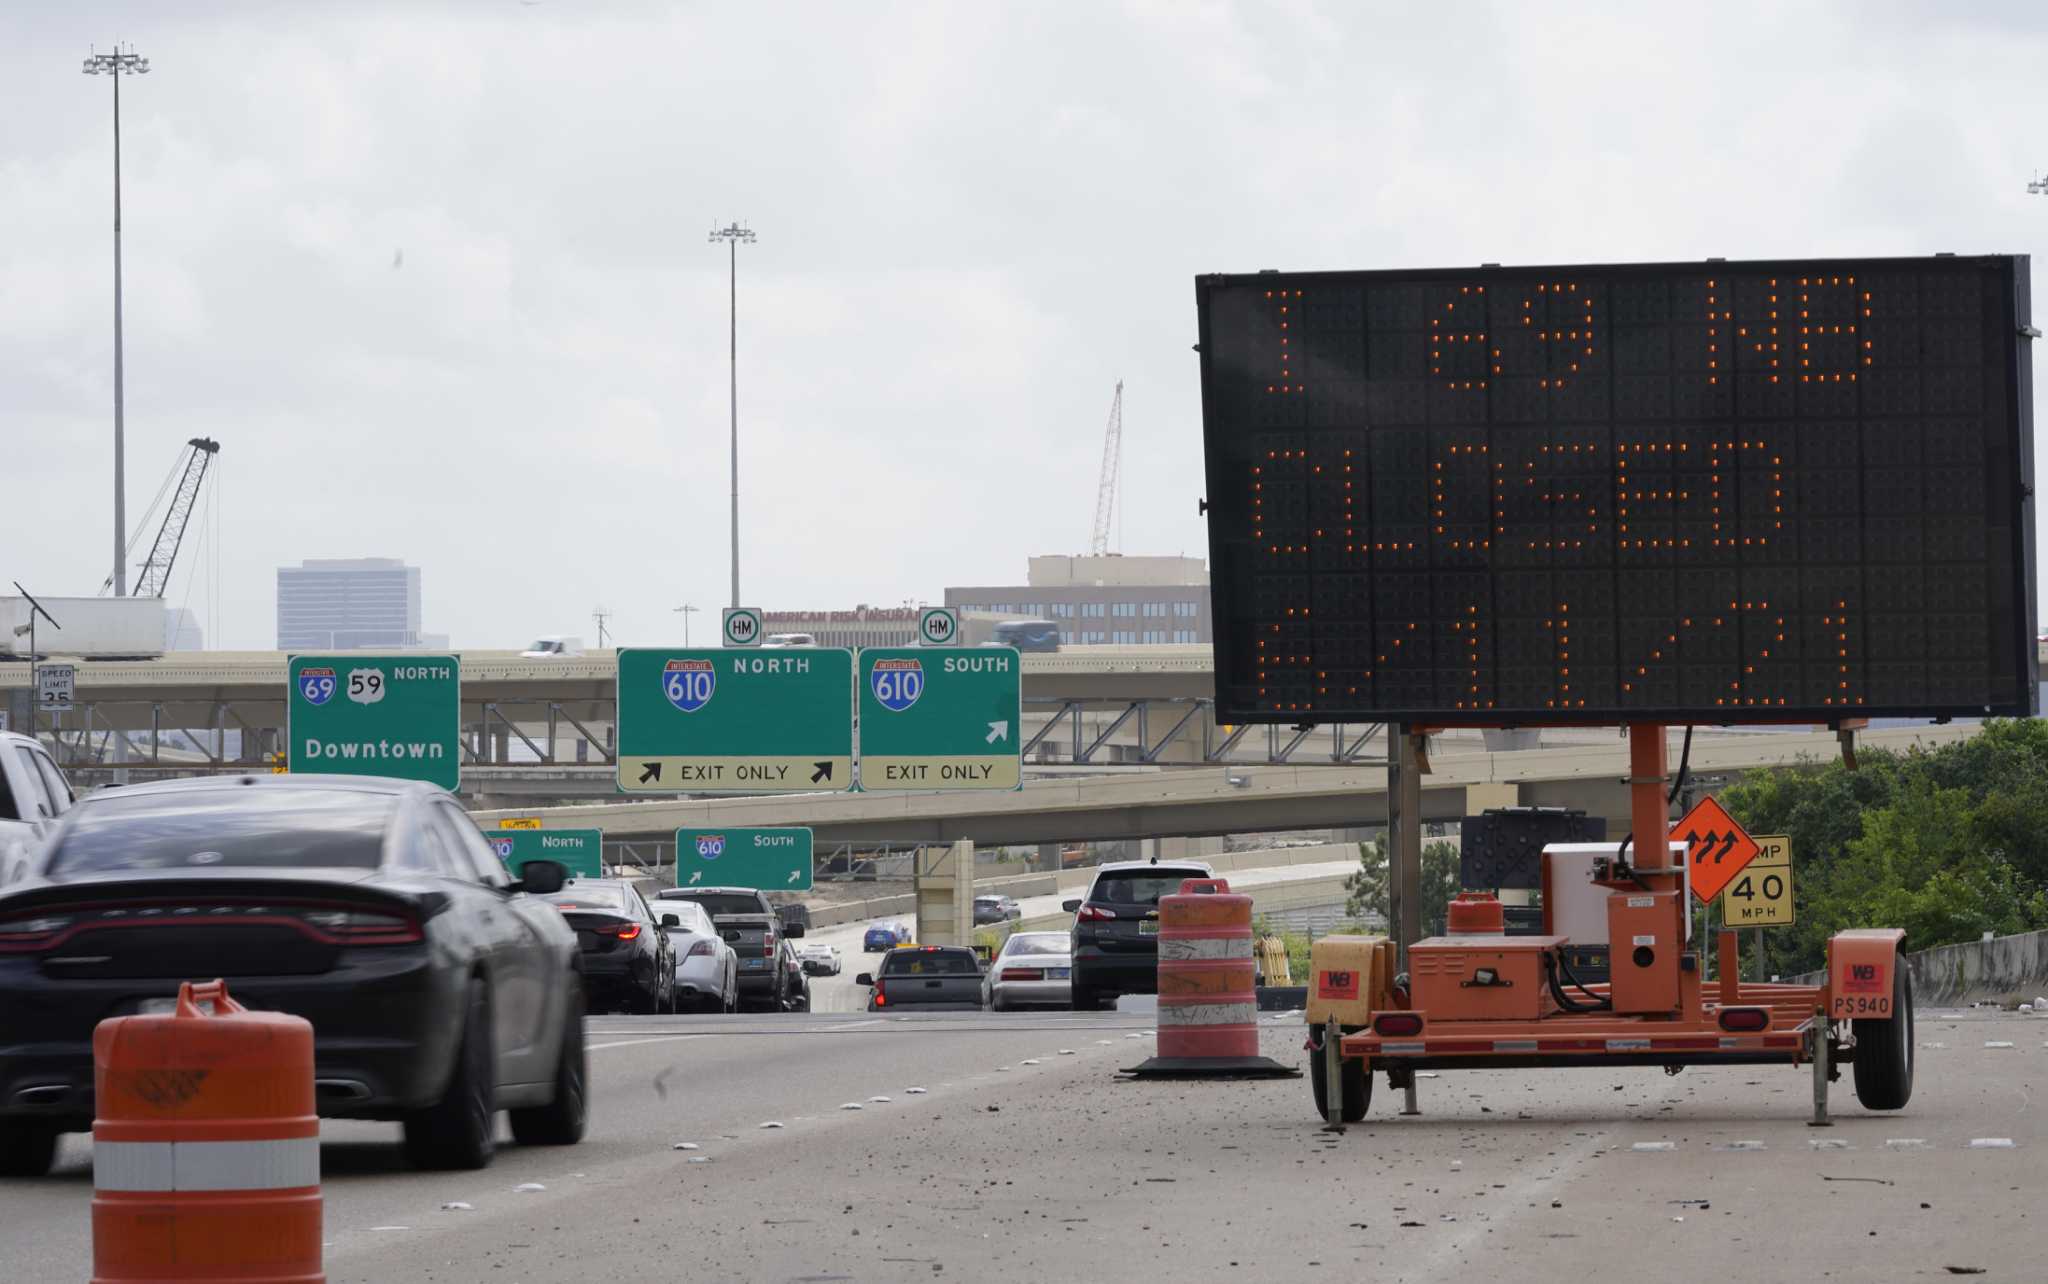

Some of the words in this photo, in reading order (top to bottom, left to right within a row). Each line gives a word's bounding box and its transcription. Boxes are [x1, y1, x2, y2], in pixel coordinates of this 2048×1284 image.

[1266, 290, 1304, 393] I
[1433, 285, 1593, 390] 69
[1708, 278, 1871, 385] NB
[1255, 442, 1782, 553] CLOSED
[733, 621, 751, 634] HM
[929, 620, 948, 633] HM
[1259, 601, 1863, 710] 6/11/21
[734, 658, 810, 673] NORTH
[944, 657, 1009, 672] SOUTH
[394, 667, 450, 680] NORTH
[305, 678, 334, 699] 69
[351, 675, 381, 695] 59
[668, 673, 711, 701] 610
[876, 672, 919, 700] 610
[306, 739, 443, 758] Downtown
[681, 765, 724, 780] EXIT
[736, 765, 789, 780] ONLY
[886, 765, 928, 780] EXIT
[940, 765, 993, 780] ONLY
[491, 843, 511, 856] 10
[699, 841, 721, 855] 610
[1732, 875, 1783, 901] 40
[1742, 908, 1776, 918] MPH
